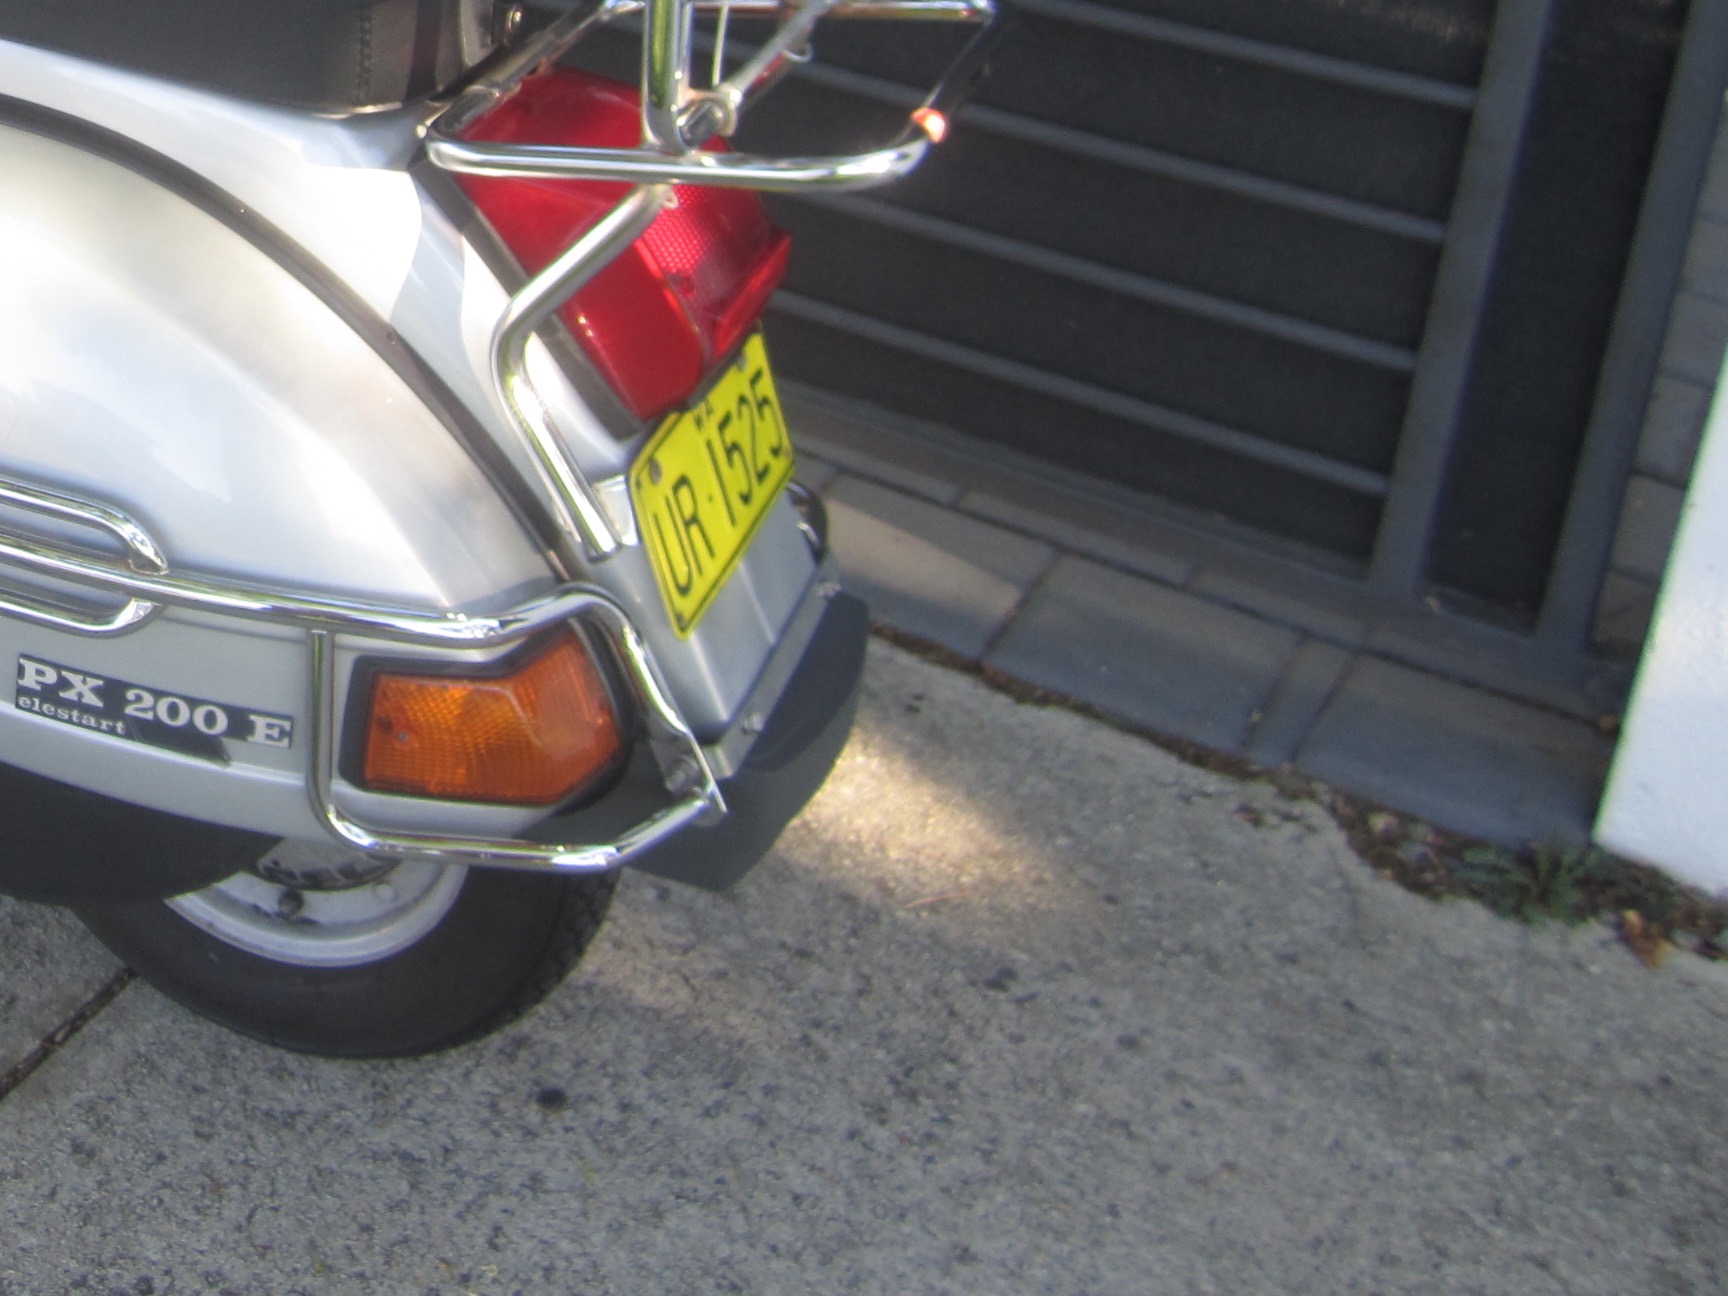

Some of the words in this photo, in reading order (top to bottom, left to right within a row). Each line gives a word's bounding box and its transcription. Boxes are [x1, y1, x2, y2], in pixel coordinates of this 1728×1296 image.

[18, 658, 104, 708] PX
[125, 689, 228, 736] 200
[247, 715, 292, 748] E
[18, 694, 126, 735] elestart
